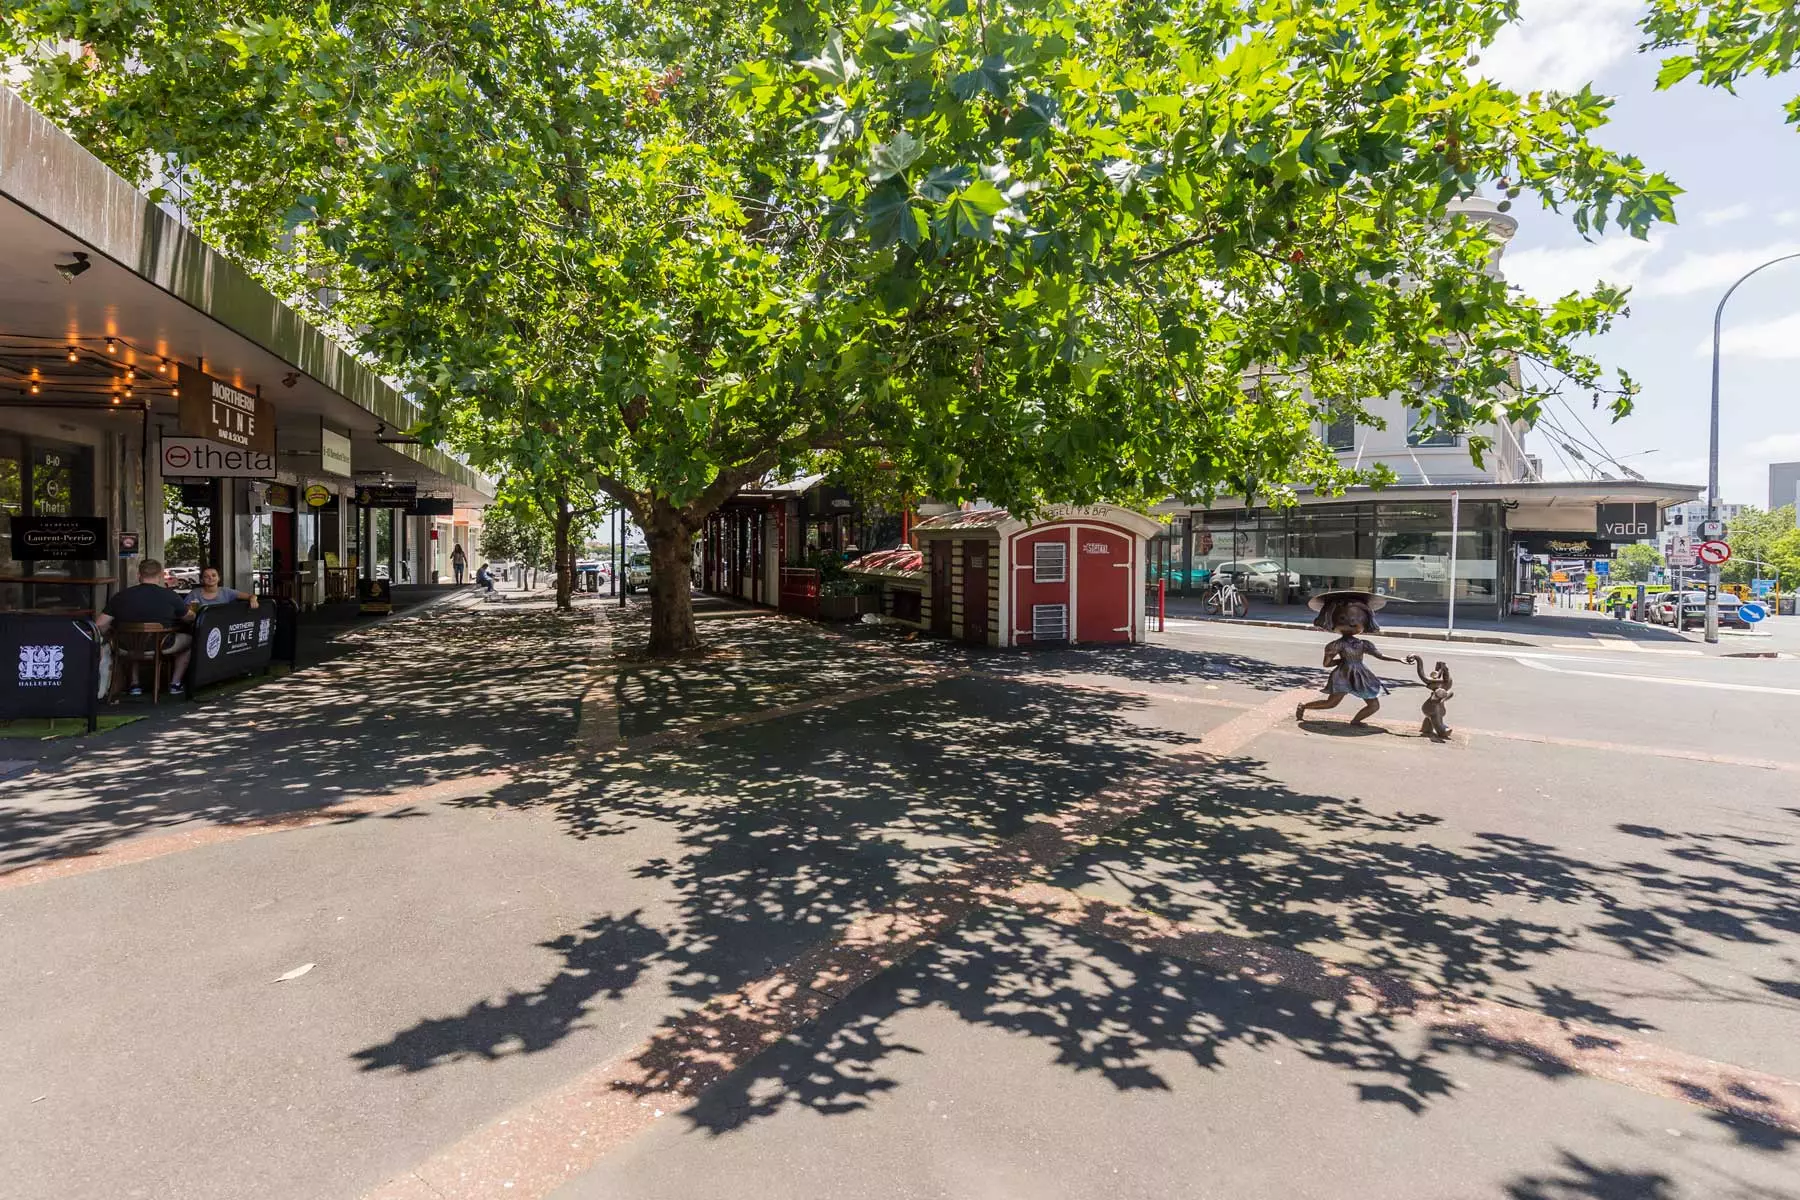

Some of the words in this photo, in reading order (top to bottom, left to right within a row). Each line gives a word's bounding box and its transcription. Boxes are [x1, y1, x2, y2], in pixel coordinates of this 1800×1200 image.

[212, 381, 255, 412] NORTHERN
[212, 403, 255, 437] LINE
[193, 445, 273, 471] theta
[40, 500, 66, 513] Theta
[27, 533, 94, 542] Laurent-Perrier
[228, 621, 255, 632] NORTHERN
[227, 630, 254, 644] LINE
